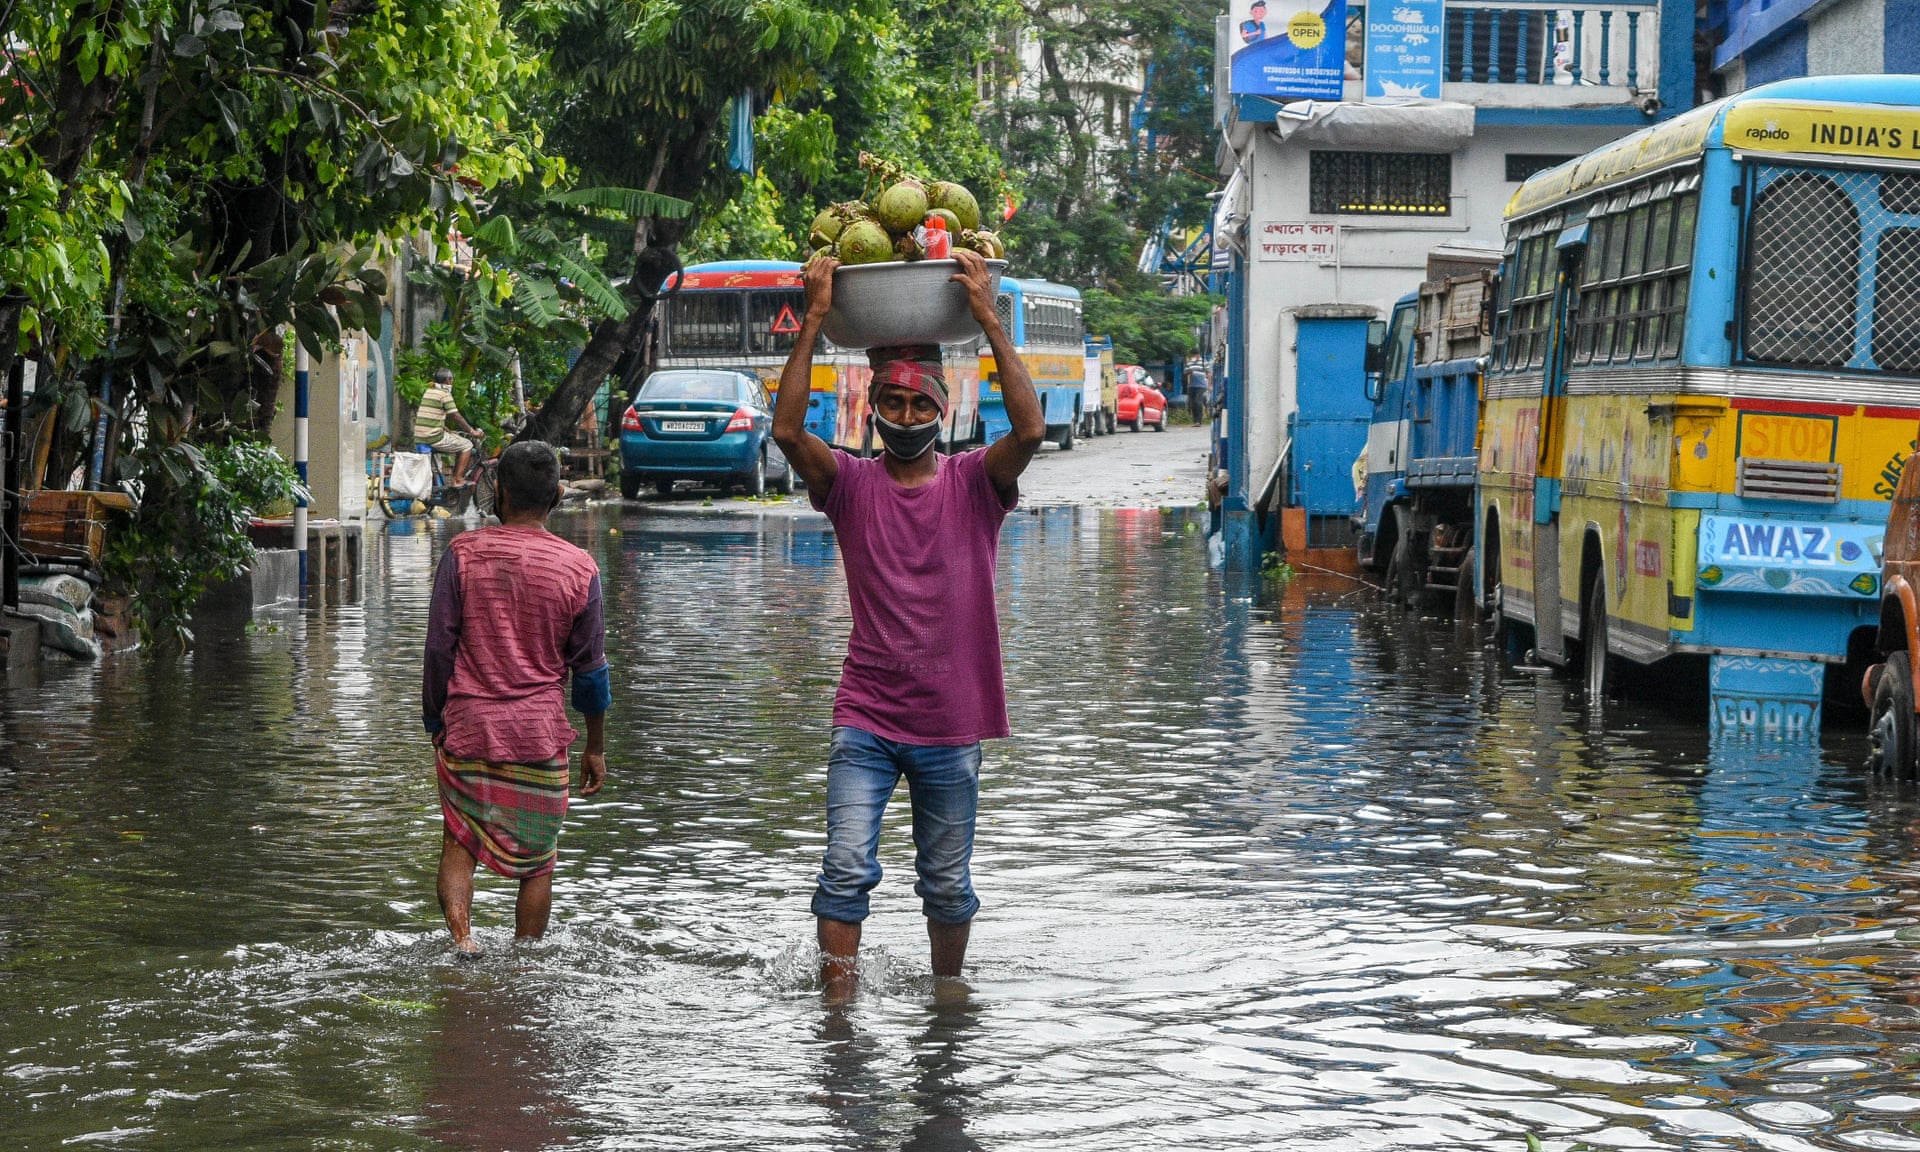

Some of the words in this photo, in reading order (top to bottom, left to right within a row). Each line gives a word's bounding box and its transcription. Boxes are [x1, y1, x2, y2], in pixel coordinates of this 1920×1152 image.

[1292, 28, 1320, 37] OPEN
[1370, 23, 1440, 34] DOODHWALA
[1746, 127, 1790, 141] rapido
[1811, 123, 1902, 148] INDIA'S
[1308, 224, 1334, 235] বাস
[1745, 416, 1831, 459] STOP
[1873, 451, 1907, 501] SAFE
[1722, 522, 1834, 565] AWAZ
